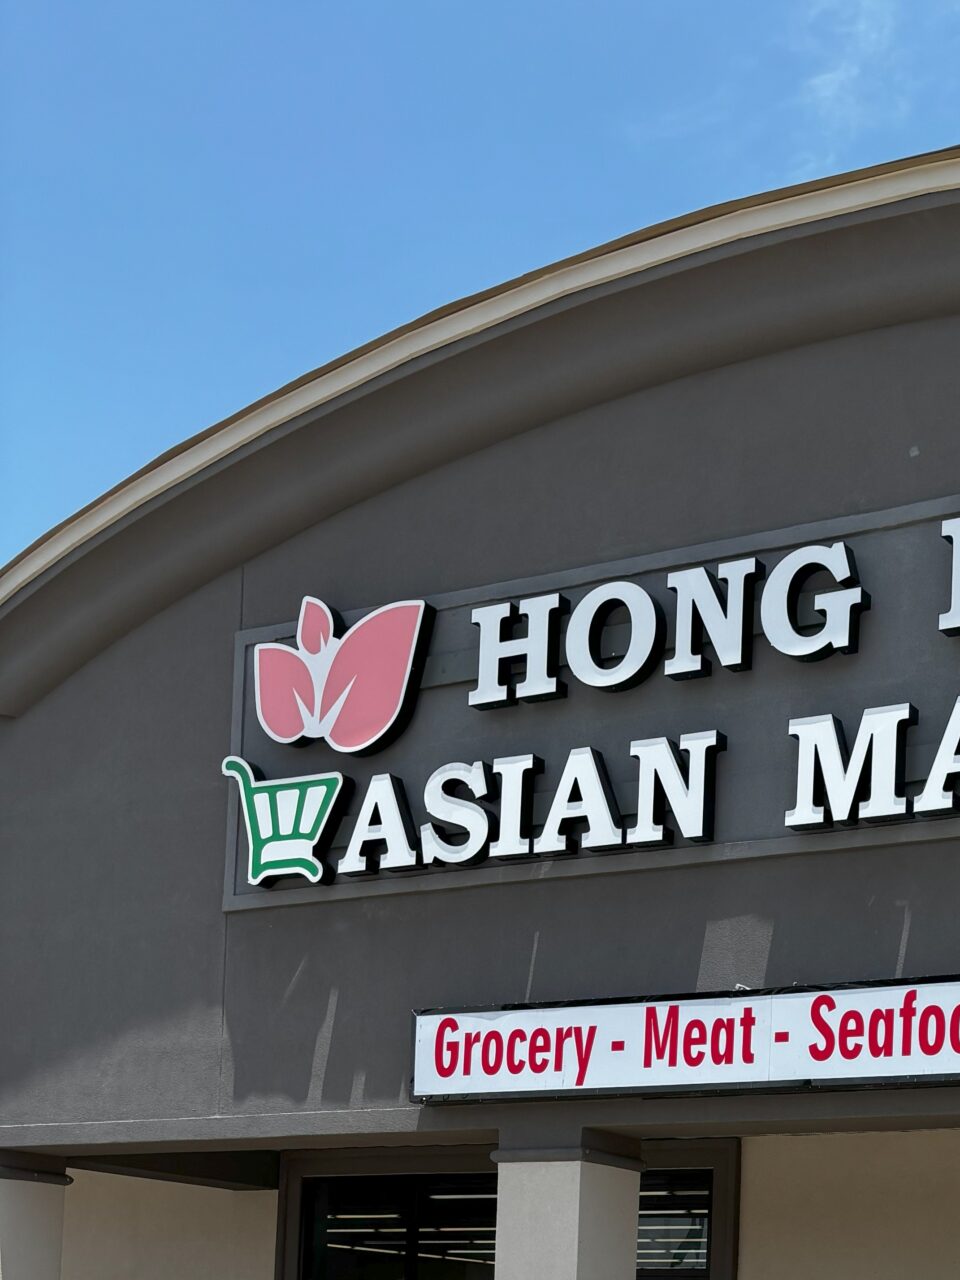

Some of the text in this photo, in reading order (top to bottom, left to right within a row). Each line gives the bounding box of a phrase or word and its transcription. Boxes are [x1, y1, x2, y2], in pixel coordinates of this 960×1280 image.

[468, 541, 862, 707] HONG
[337, 729, 718, 874] ASIAN
[433, 1017, 597, 1086] Grocery
[643, 1005, 756, 1068] Meat
